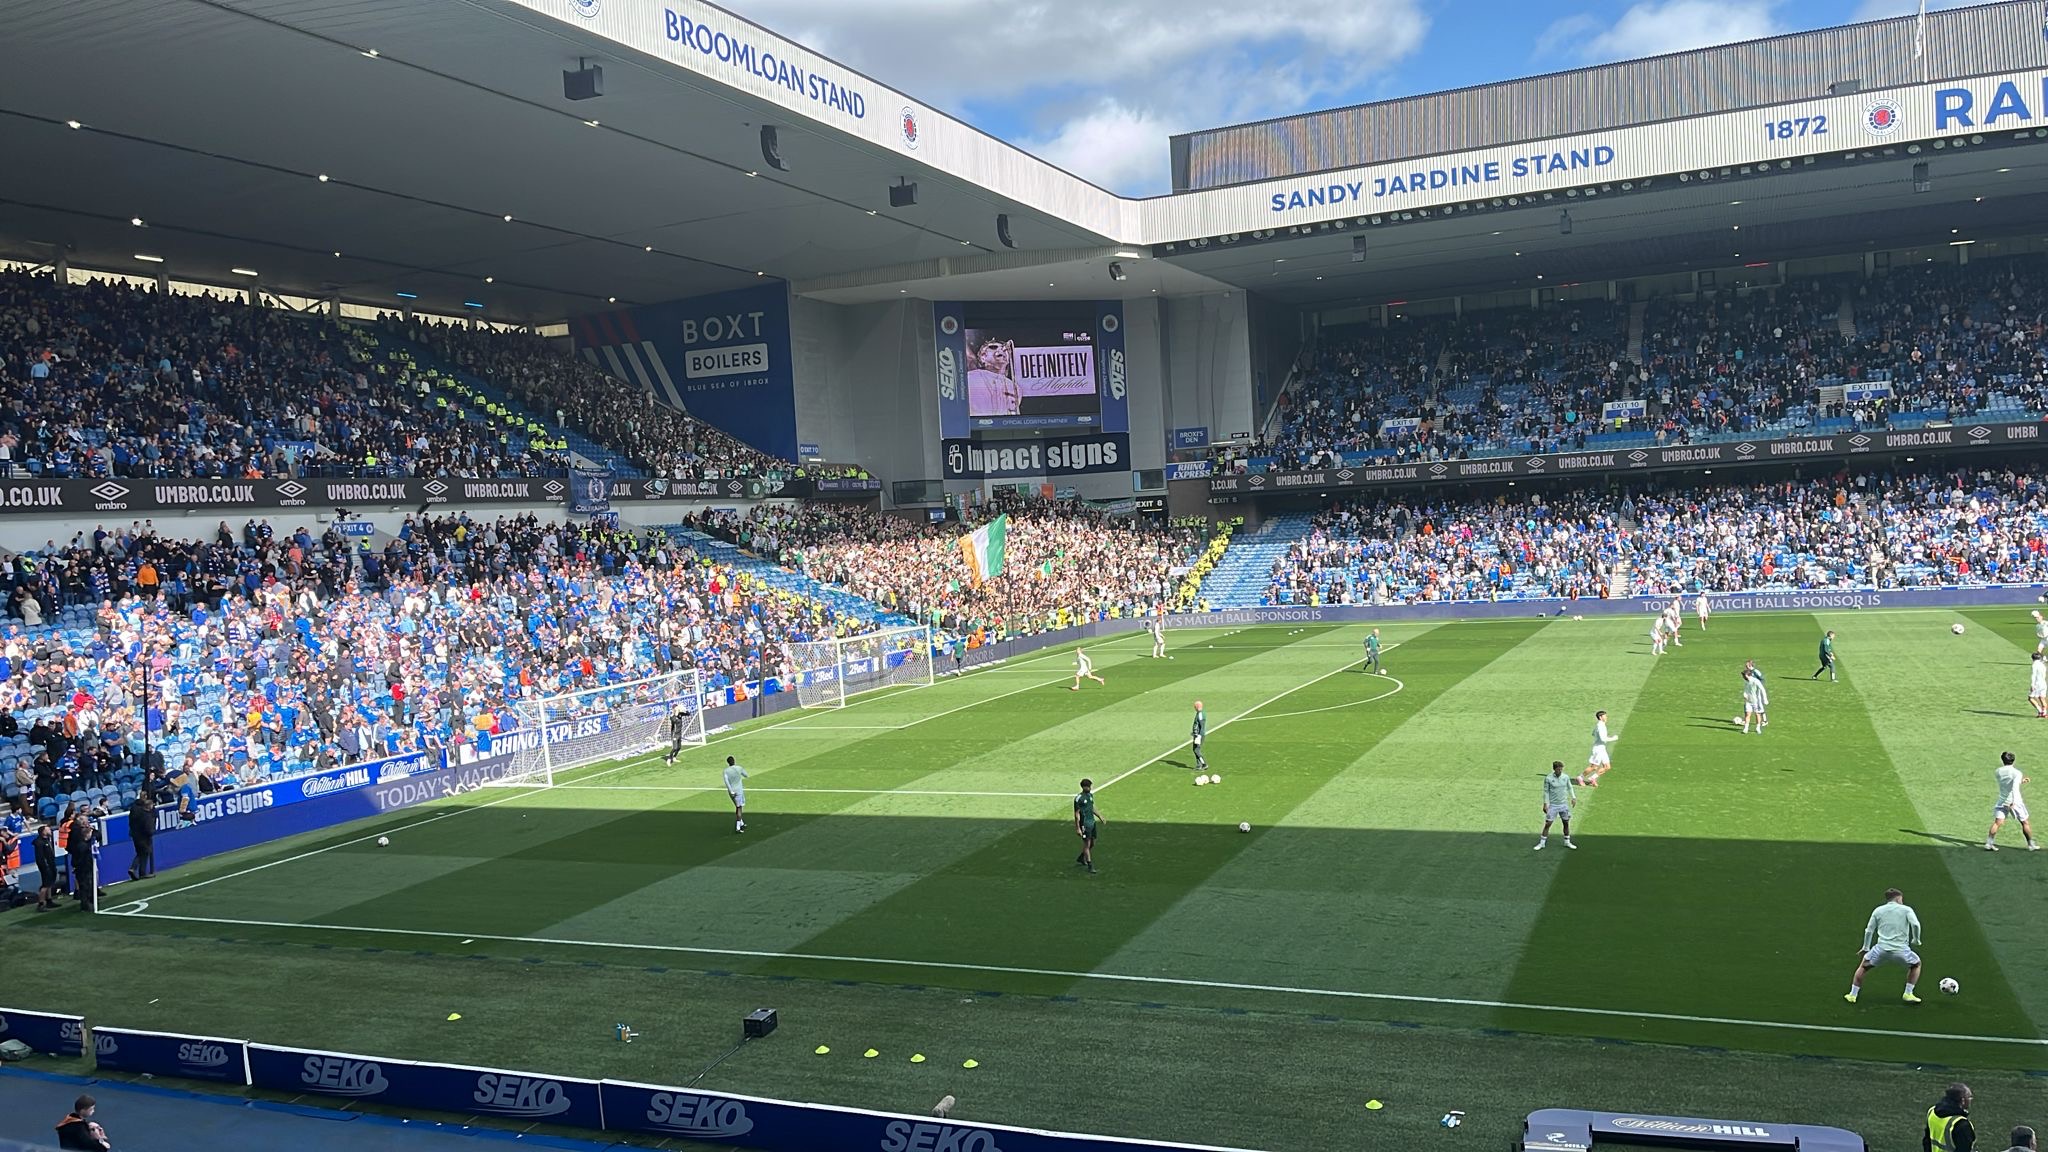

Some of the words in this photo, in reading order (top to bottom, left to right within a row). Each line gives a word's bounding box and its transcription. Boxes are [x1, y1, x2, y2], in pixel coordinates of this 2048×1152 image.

[664, 8, 805, 96] BROOMLOAN
[808, 74, 866, 119] STAND
[1934, 77, 2048, 131] RA
[1765, 115, 1828, 141] 1872
[1271, 181, 1364, 213] SANDY
[1373, 161, 1500, 198] JARDINE
[1511, 145, 1615, 177] STAND
[682, 312, 764, 344] BOXT
[692, 350, 762, 371] BOILERS
[1020, 352, 1087, 378] DEFINITELY
[710, 382, 725, 390] SEA
[743, 378, 768, 387] IBROX
[938, 347, 958, 400] SEKO
[1111, 349, 1126, 400] SEKO
[1771, 439, 1833, 455] UMBRO.CO.UK
[1886, 431, 1952, 447] UMBRO.CO.UK
[967, 445, 1040, 473] Impact
[1048, 441, 1118, 469] signs
[1558, 454, 1615, 469] UMBRO.CO.UK
[1662, 447, 1721, 462] UMBRO.CO.UK
[1173, 469, 1212, 480] EXPRESS
[1178, 463, 1205, 472] RHINO
[1366, 467, 1417, 481] UMBRO.CO.UK
[1460, 461, 1514, 476] UMBRO.CO.UK
[1276, 473, 1325, 486] UMBRO.CO.UK
[155, 484, 254, 504] UMBRO.CO.UK
[327, 483, 406, 500] UMBRO.CO.UK
[426, 496, 448, 504] umbro
[464, 483, 530, 498] UMBRO.CO.UK
[545, 494, 564, 502] umbro
[95, 502, 128, 511] umbro
[1755, 598, 1790, 609] BALL
[1792, 595, 1864, 607] SPONSOR
[1868, 594, 1881, 605] IS
[1184, 615, 1224, 627] MATCH
[1226, 612, 1253, 623] BALL
[1255, 610, 1309, 622] SPONSOR
[1312, 610, 1322, 620] IS
[490, 731, 540, 758] RHINO
[380, 758, 419, 779] William
[302, 772, 346, 797] William
[346, 768, 370, 787] HILL
[376, 775, 451, 809] TODAY'S
[158, 798, 224, 831] Imact
[225, 789, 274, 815] signs
[177, 1043, 229, 1065] SEKO
[301, 1056, 388, 1095] SEKO
[473, 1073, 571, 1115] SEKO
[646, 1092, 754, 1137] SEKO
[880, 1120, 1003, 1152] SEKO
[1611, 1117, 1712, 1133] William
[1712, 1125, 1770, 1137] HILL
